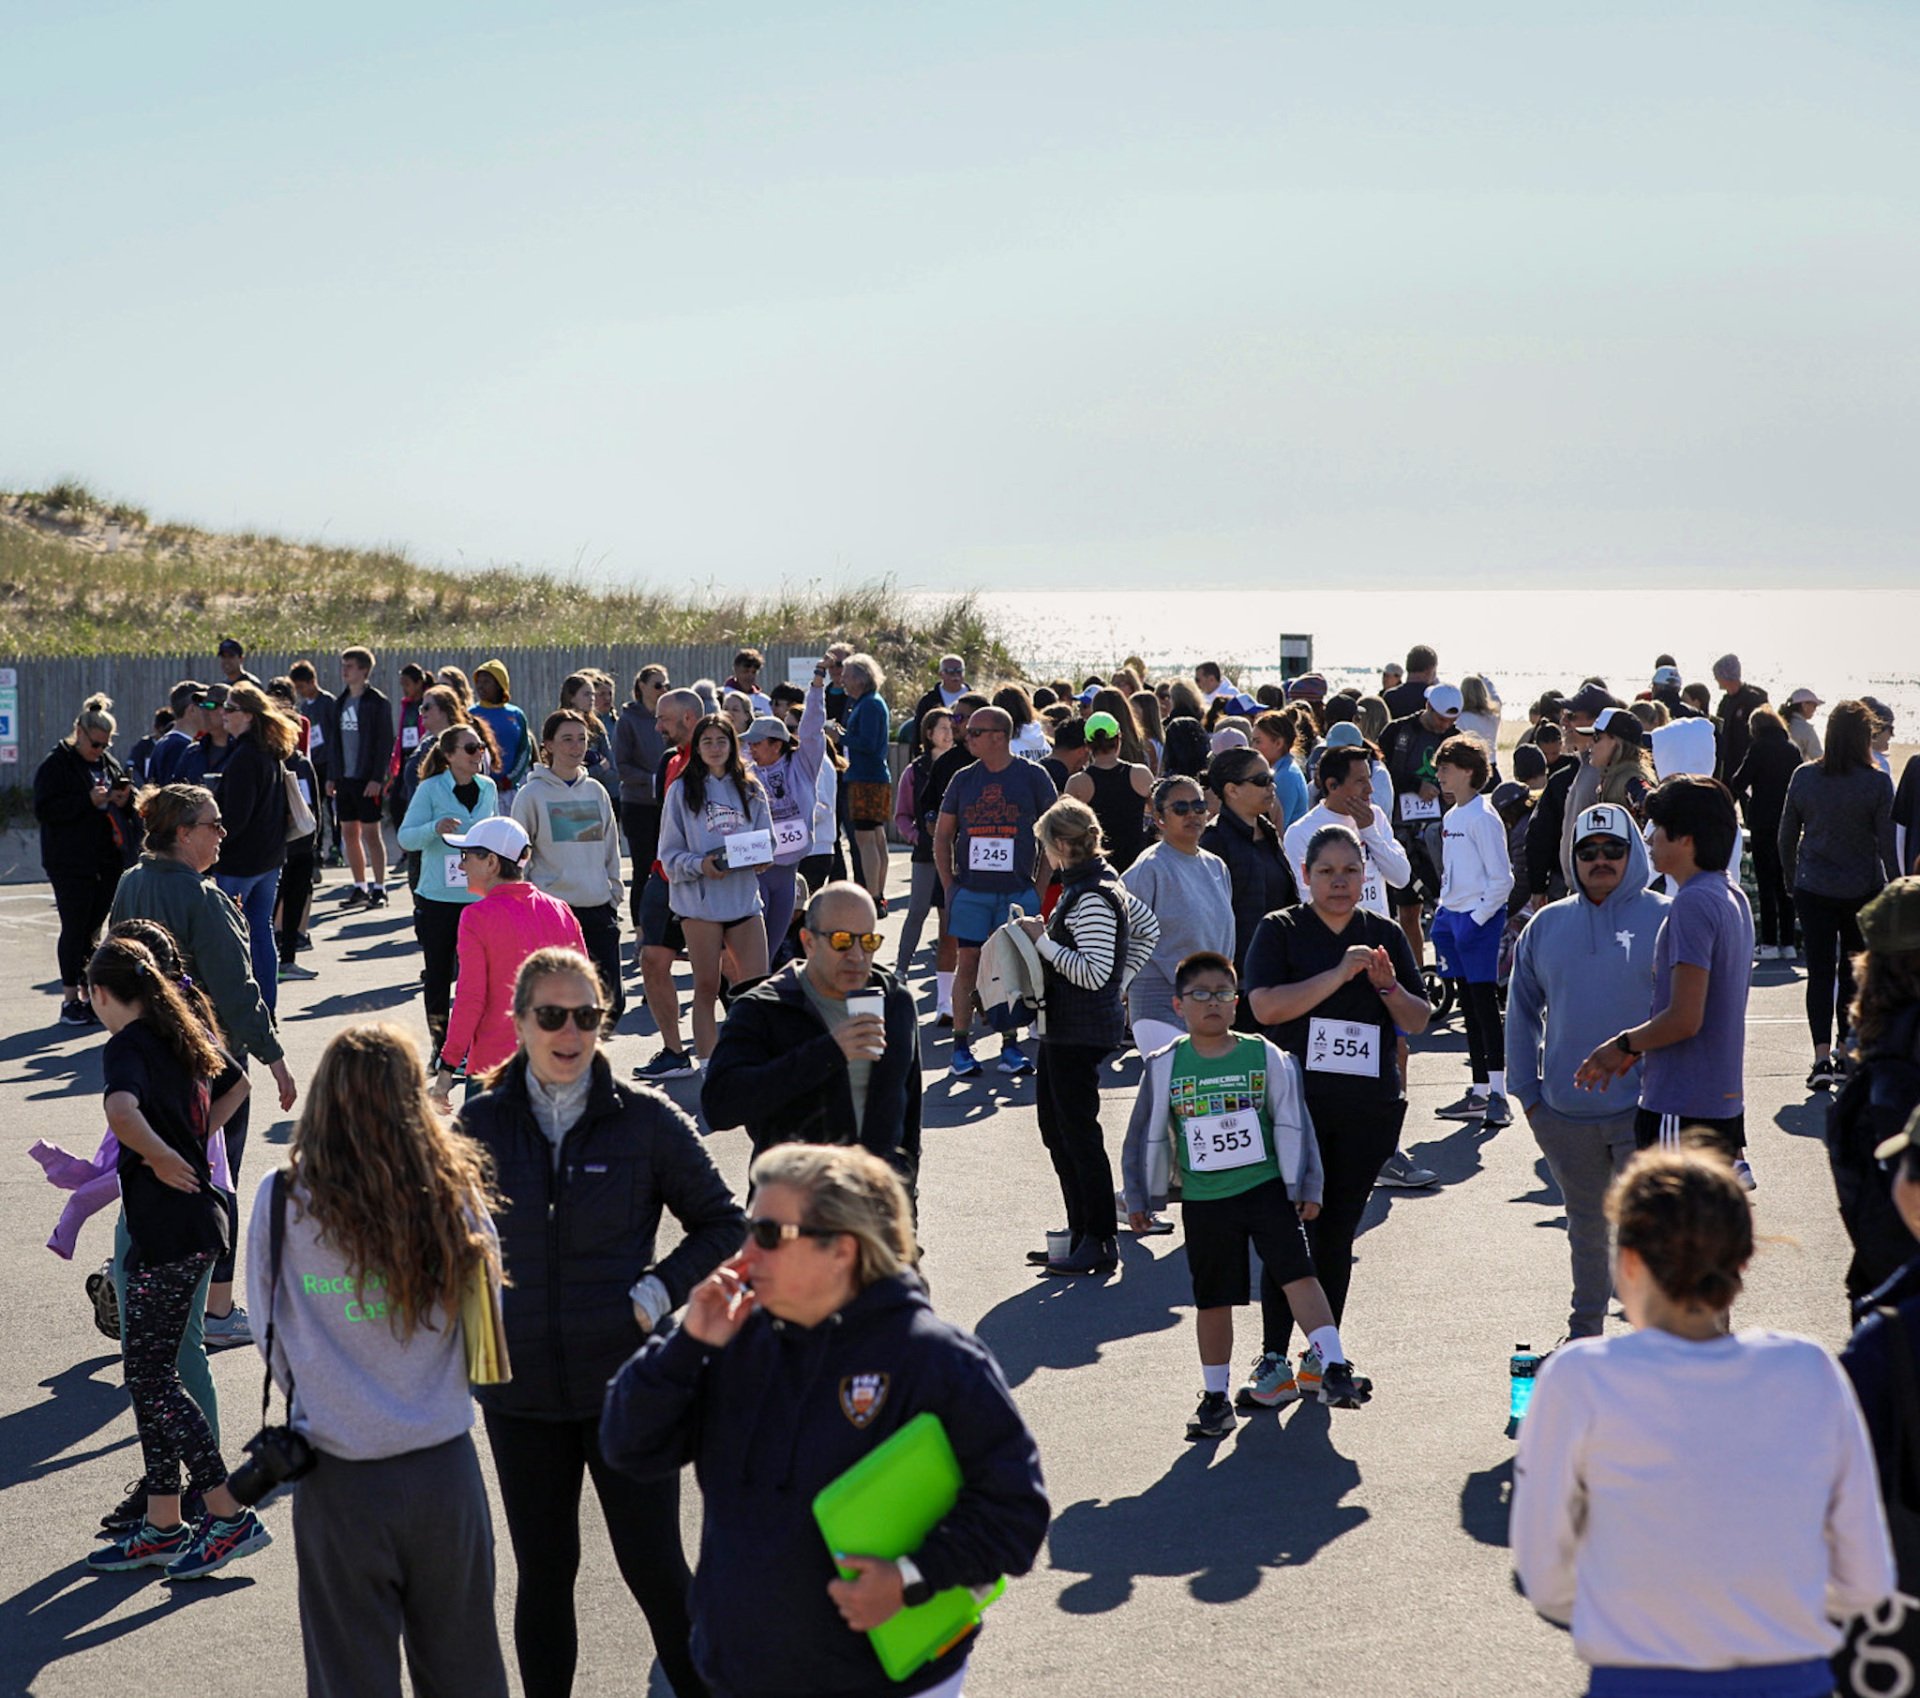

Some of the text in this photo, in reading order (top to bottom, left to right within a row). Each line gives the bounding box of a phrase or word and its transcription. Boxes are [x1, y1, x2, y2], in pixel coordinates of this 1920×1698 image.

[780, 830, 803, 844] 363
[983, 848, 1008, 861] 245
[1332, 1038, 1370, 1060] 554
[1212, 1128, 1252, 1153] 553
[303, 1272, 356, 1296] Race
